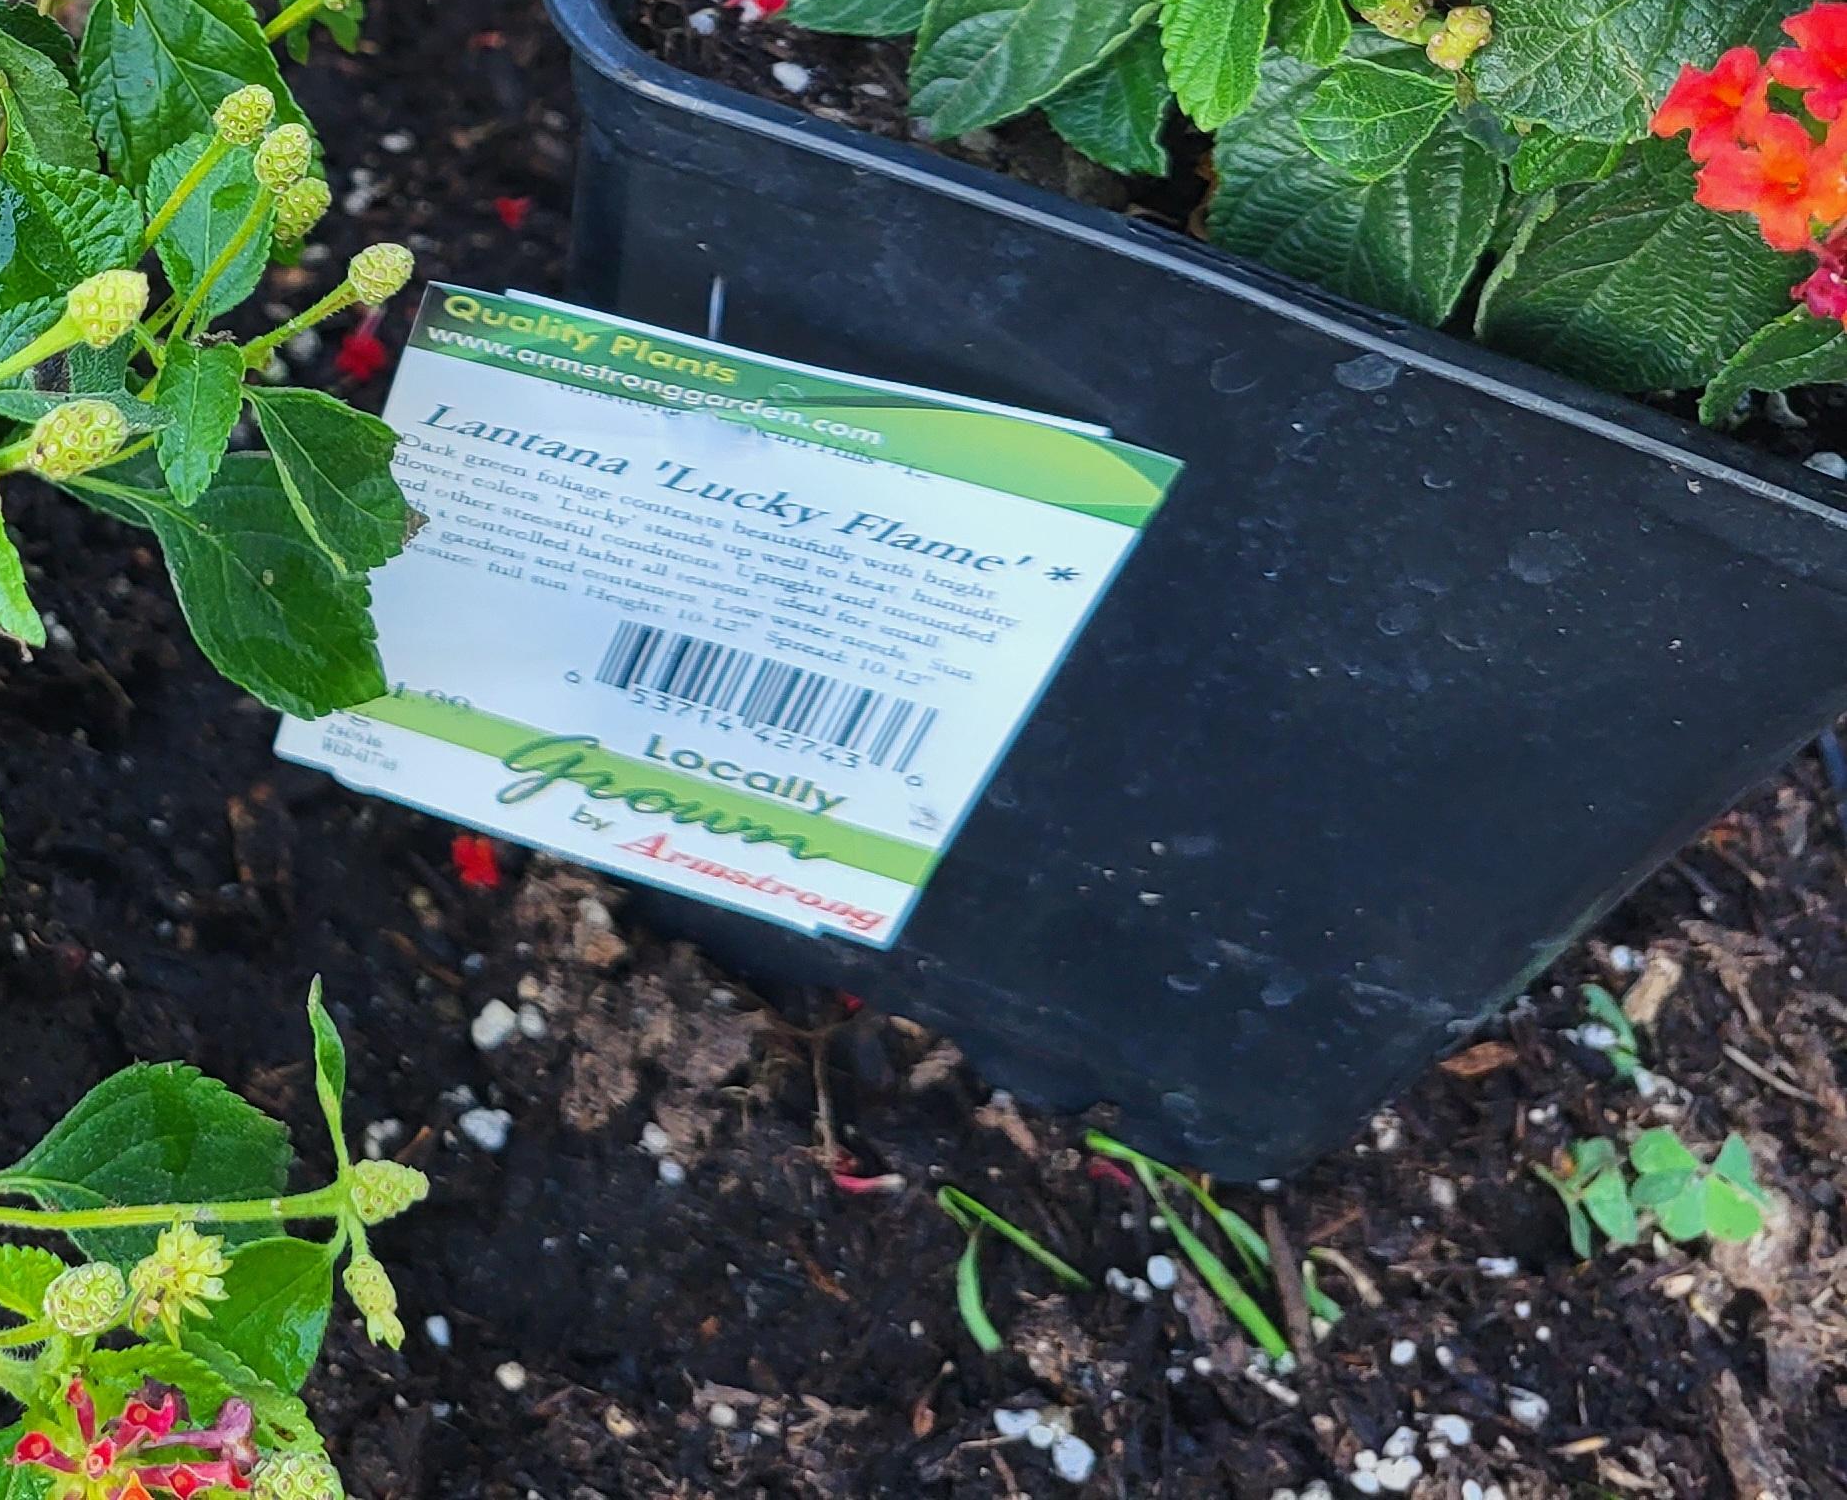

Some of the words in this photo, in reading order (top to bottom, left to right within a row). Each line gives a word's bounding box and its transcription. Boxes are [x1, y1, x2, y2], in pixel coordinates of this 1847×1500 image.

[427, 325, 883, 445] www.armstronggarden.com
[443, 295, 599, 351] Quality
[610, 334, 738, 386] Plants
[393, 452, 465, 482] flower
[471, 476, 540, 502] colors
[643, 523, 714, 549] stands
[722, 542, 752, 561] up
[760, 551, 809, 572] well
[816, 563, 839, 579] to
[401, 432, 456, 458] Dark
[463, 453, 527, 477] green
[536, 469, 612, 501] foliage
[620, 494, 724, 529] contrasts
[733, 520, 854, 564] beautifully
[861, 556, 914, 579] with
[922, 568, 998, 600] bright
[418, 403, 629, 476] Lantana
[656, 460, 830, 528] 'Lucky
[832, 510, 1034, 572] Flame'
[435, 489, 497, 512] other
[502, 505, 594, 538] stressful
[736, 563, 826, 595] Upright
[831, 590, 876, 610] and
[882, 603, 997, 644] mounded
[440, 530, 527, 561] gardens
[534, 555, 576, 574] and
[712, 597, 765, 619] Low
[769, 613, 836, 640] water
[928, 657, 975, 683] Sun
[455, 514, 571, 552] controlled
[576, 542, 636, 569] habit
[641, 562, 669, 577] all
[676, 571, 750, 597] season
[773, 595, 830, 617] ideal
[836, 608, 872, 629] for
[878, 623, 940, 649] small
[487, 561, 524, 581] full
[530, 573, 569, 592] sun
[564, 669, 582, 686] 6
[629, 687, 734, 732] 53714
[753, 724, 862, 770] 42743
[642, 732, 849, 816] Locally
[496, 734, 832, 860] Grown
[568, 803, 616, 832] by
[613, 831, 887, 931] Armstrong
